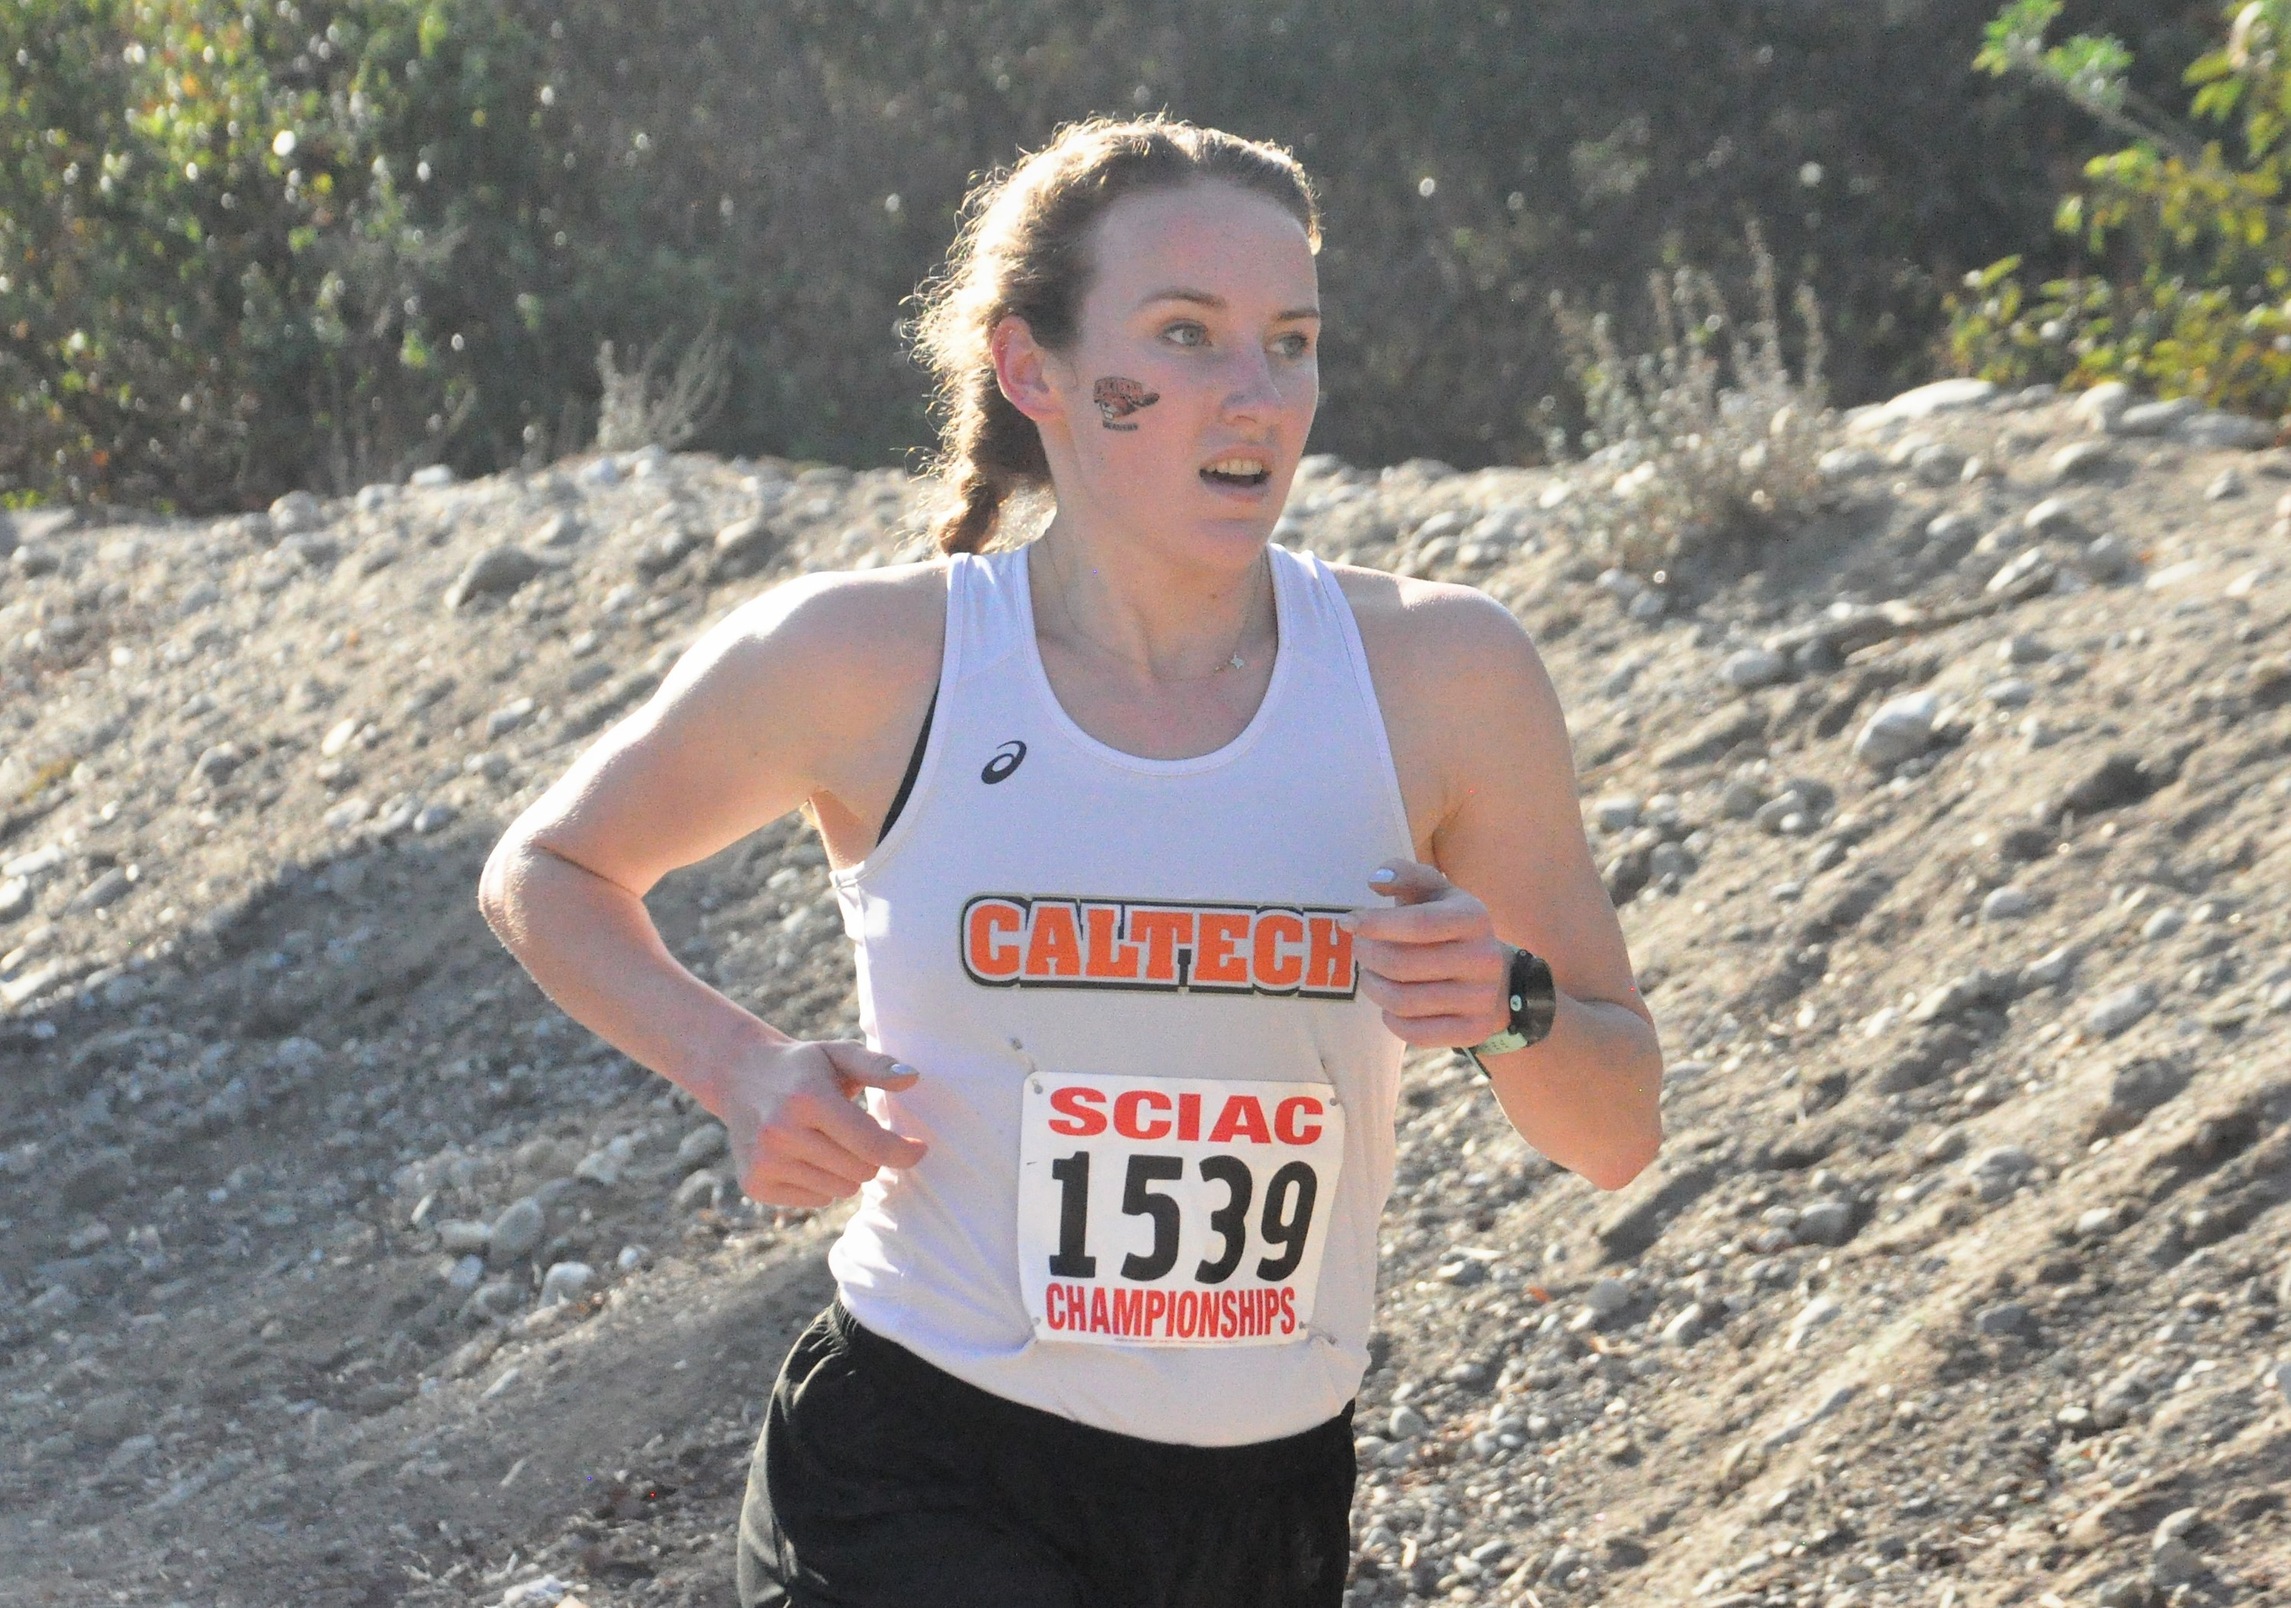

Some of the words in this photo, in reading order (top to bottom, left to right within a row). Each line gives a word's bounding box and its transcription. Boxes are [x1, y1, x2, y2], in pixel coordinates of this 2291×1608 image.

[965, 898, 1356, 995] CALTECH
[1048, 1086, 1323, 1145] SCIAC
[1049, 1151, 1318, 1284] 1539
[1045, 1282, 1296, 1339] CHAMPIONSHIPS
